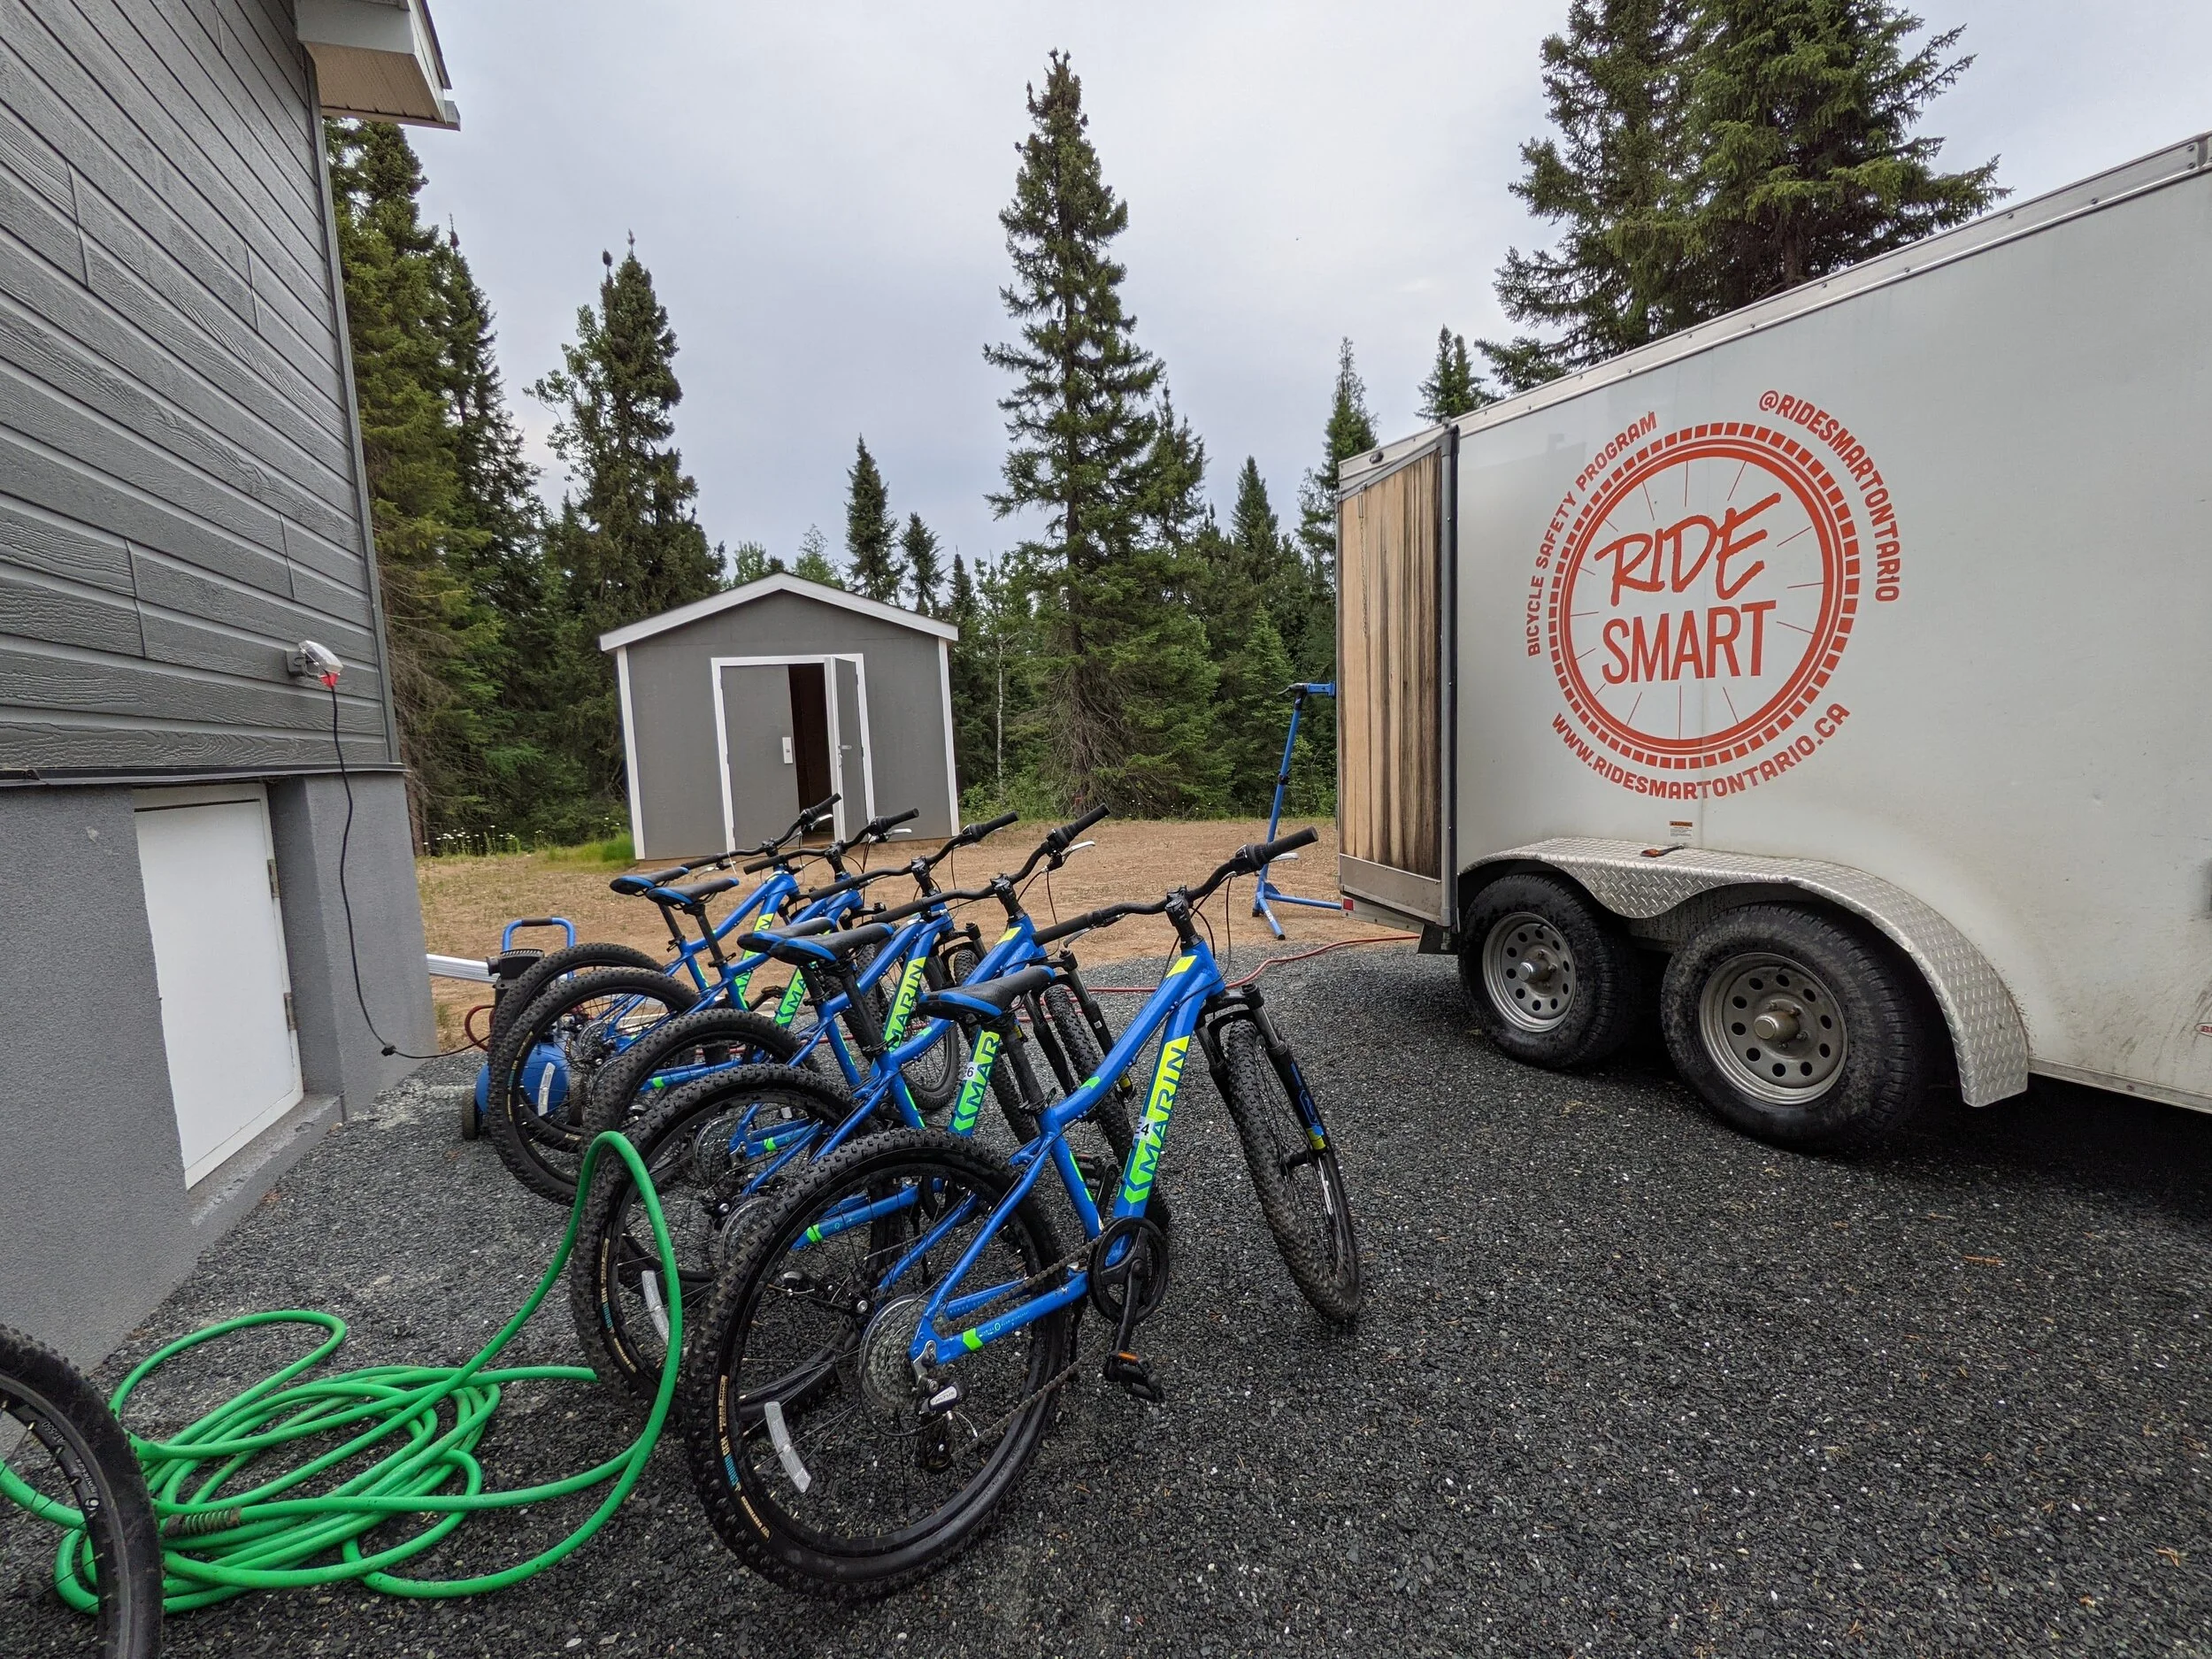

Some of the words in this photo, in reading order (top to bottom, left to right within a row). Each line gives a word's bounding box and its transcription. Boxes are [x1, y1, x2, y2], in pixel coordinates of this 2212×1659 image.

[1527, 576, 1545, 657] BICYCLE
[1536, 490, 1578, 569] SAFETY
[1576, 411, 1658, 492] PROGRAM
[1594, 492, 1782, 606] RIDE
[1759, 389, 1901, 602] @RIDESMARTONTARIO
[1601, 600, 1777, 685] SMART
[1552, 703, 1851, 800] WWW.RIDESMARTONTARIO.CA
[965, 1036, 1001, 1109] MAR
[1138, 1047, 1187, 1178] MARIN
